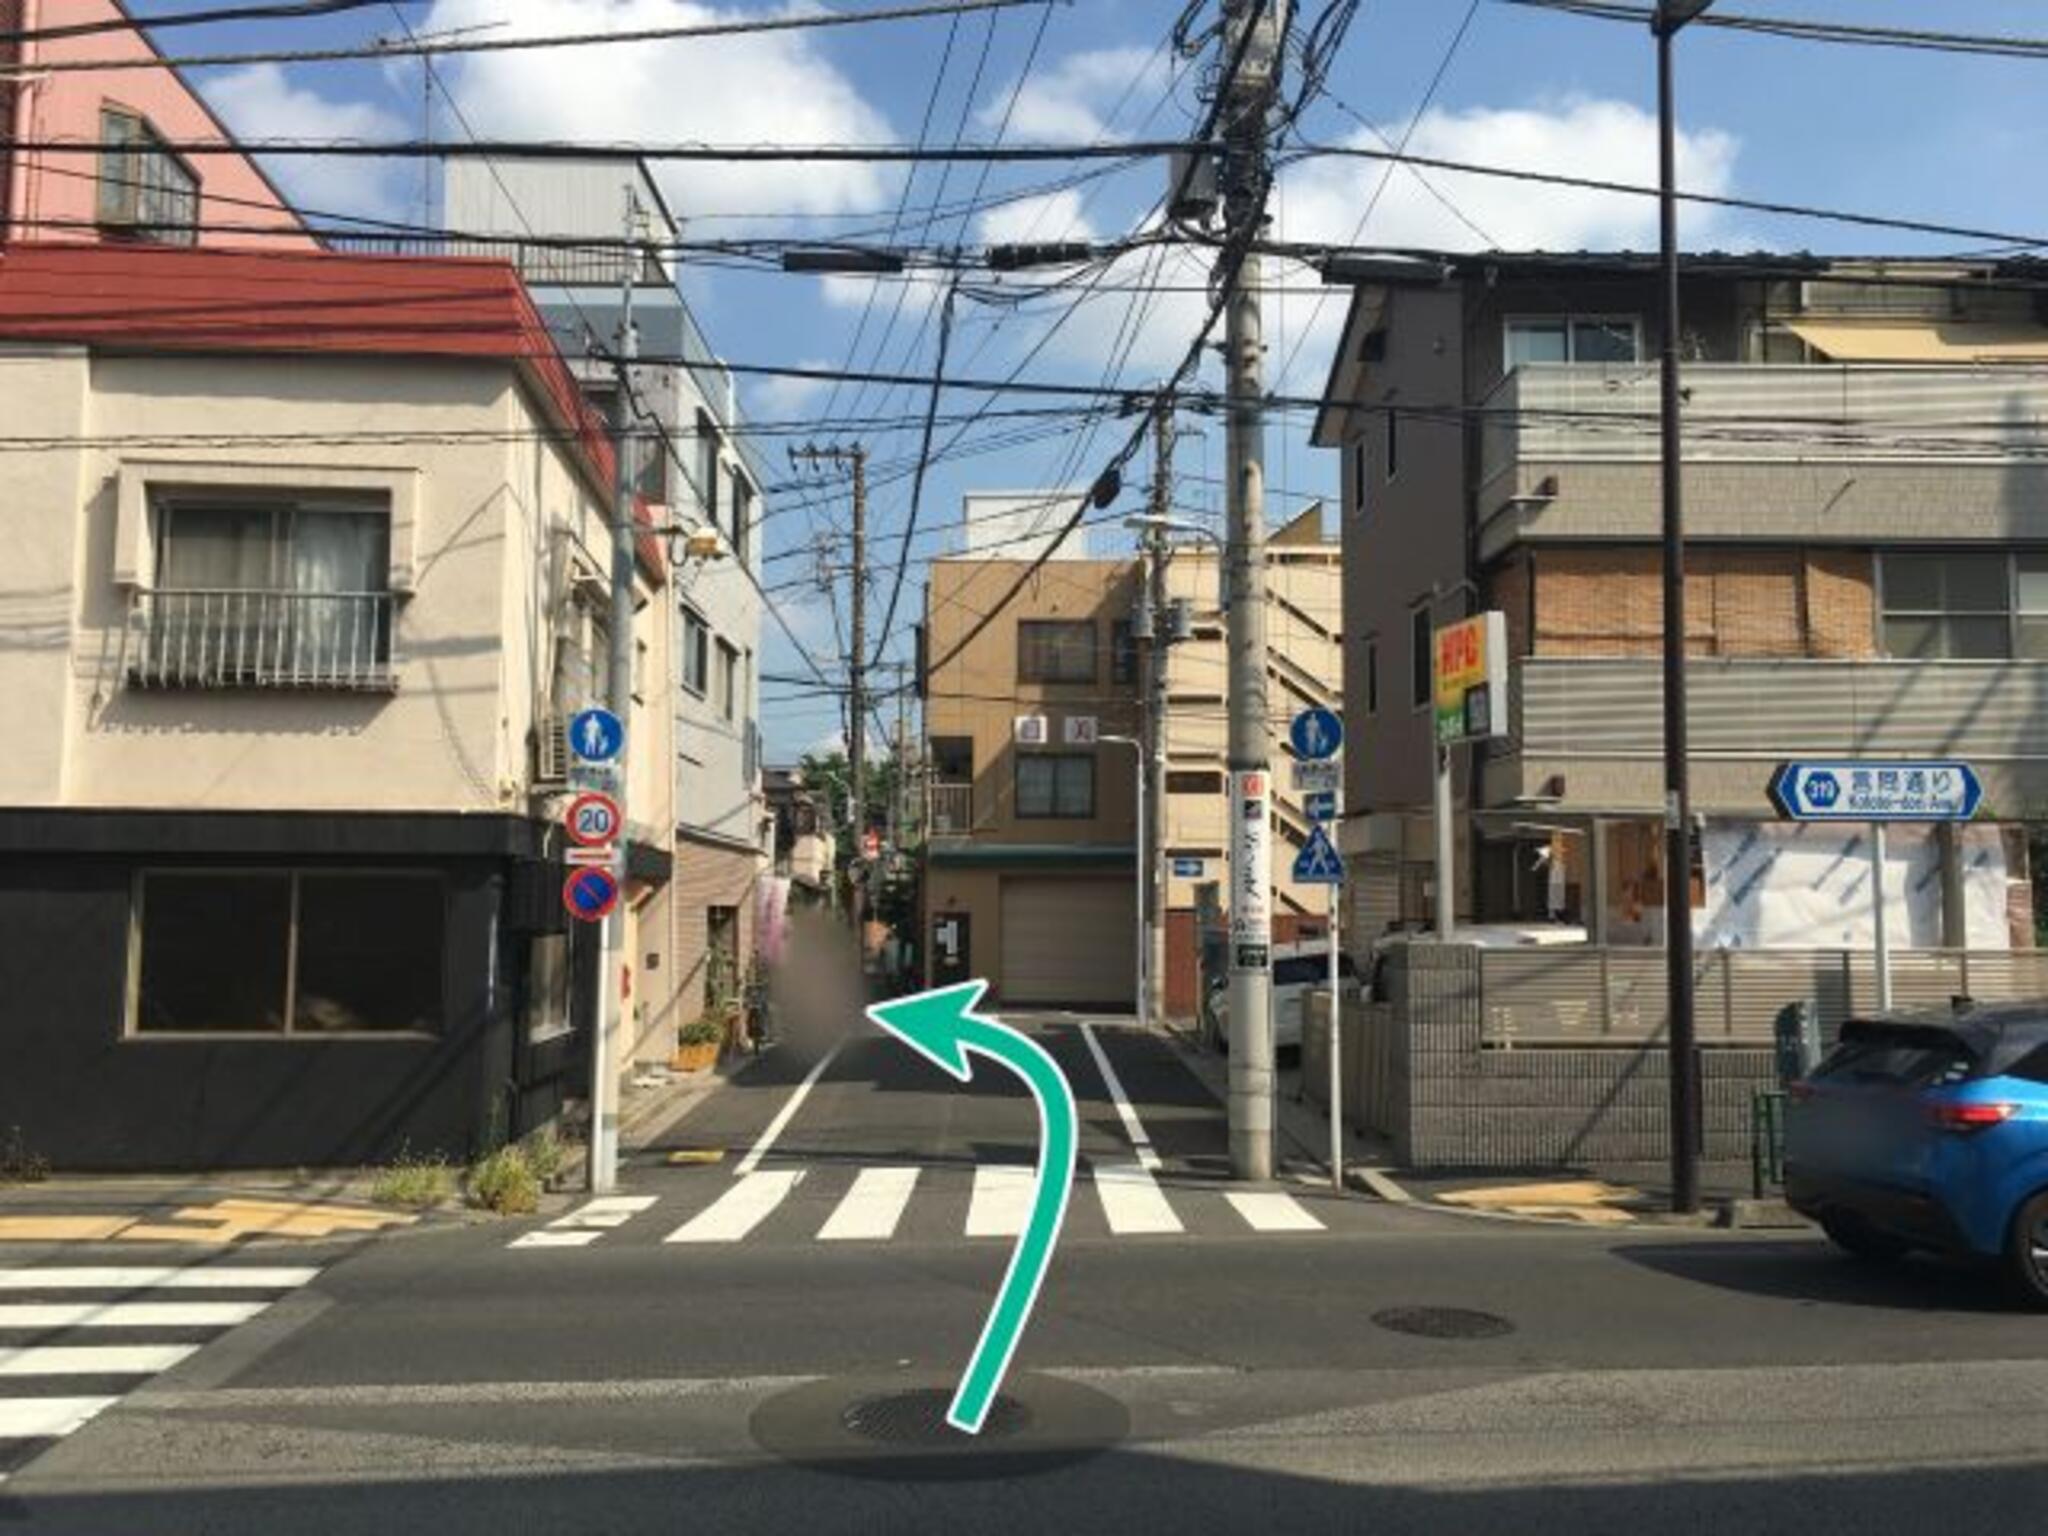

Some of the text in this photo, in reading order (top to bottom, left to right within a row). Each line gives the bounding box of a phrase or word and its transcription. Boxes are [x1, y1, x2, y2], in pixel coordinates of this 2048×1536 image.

[1441, 624, 1479, 677] NPC
[1809, 779, 1835, 800] 319
[579, 808, 609, 833] 20
